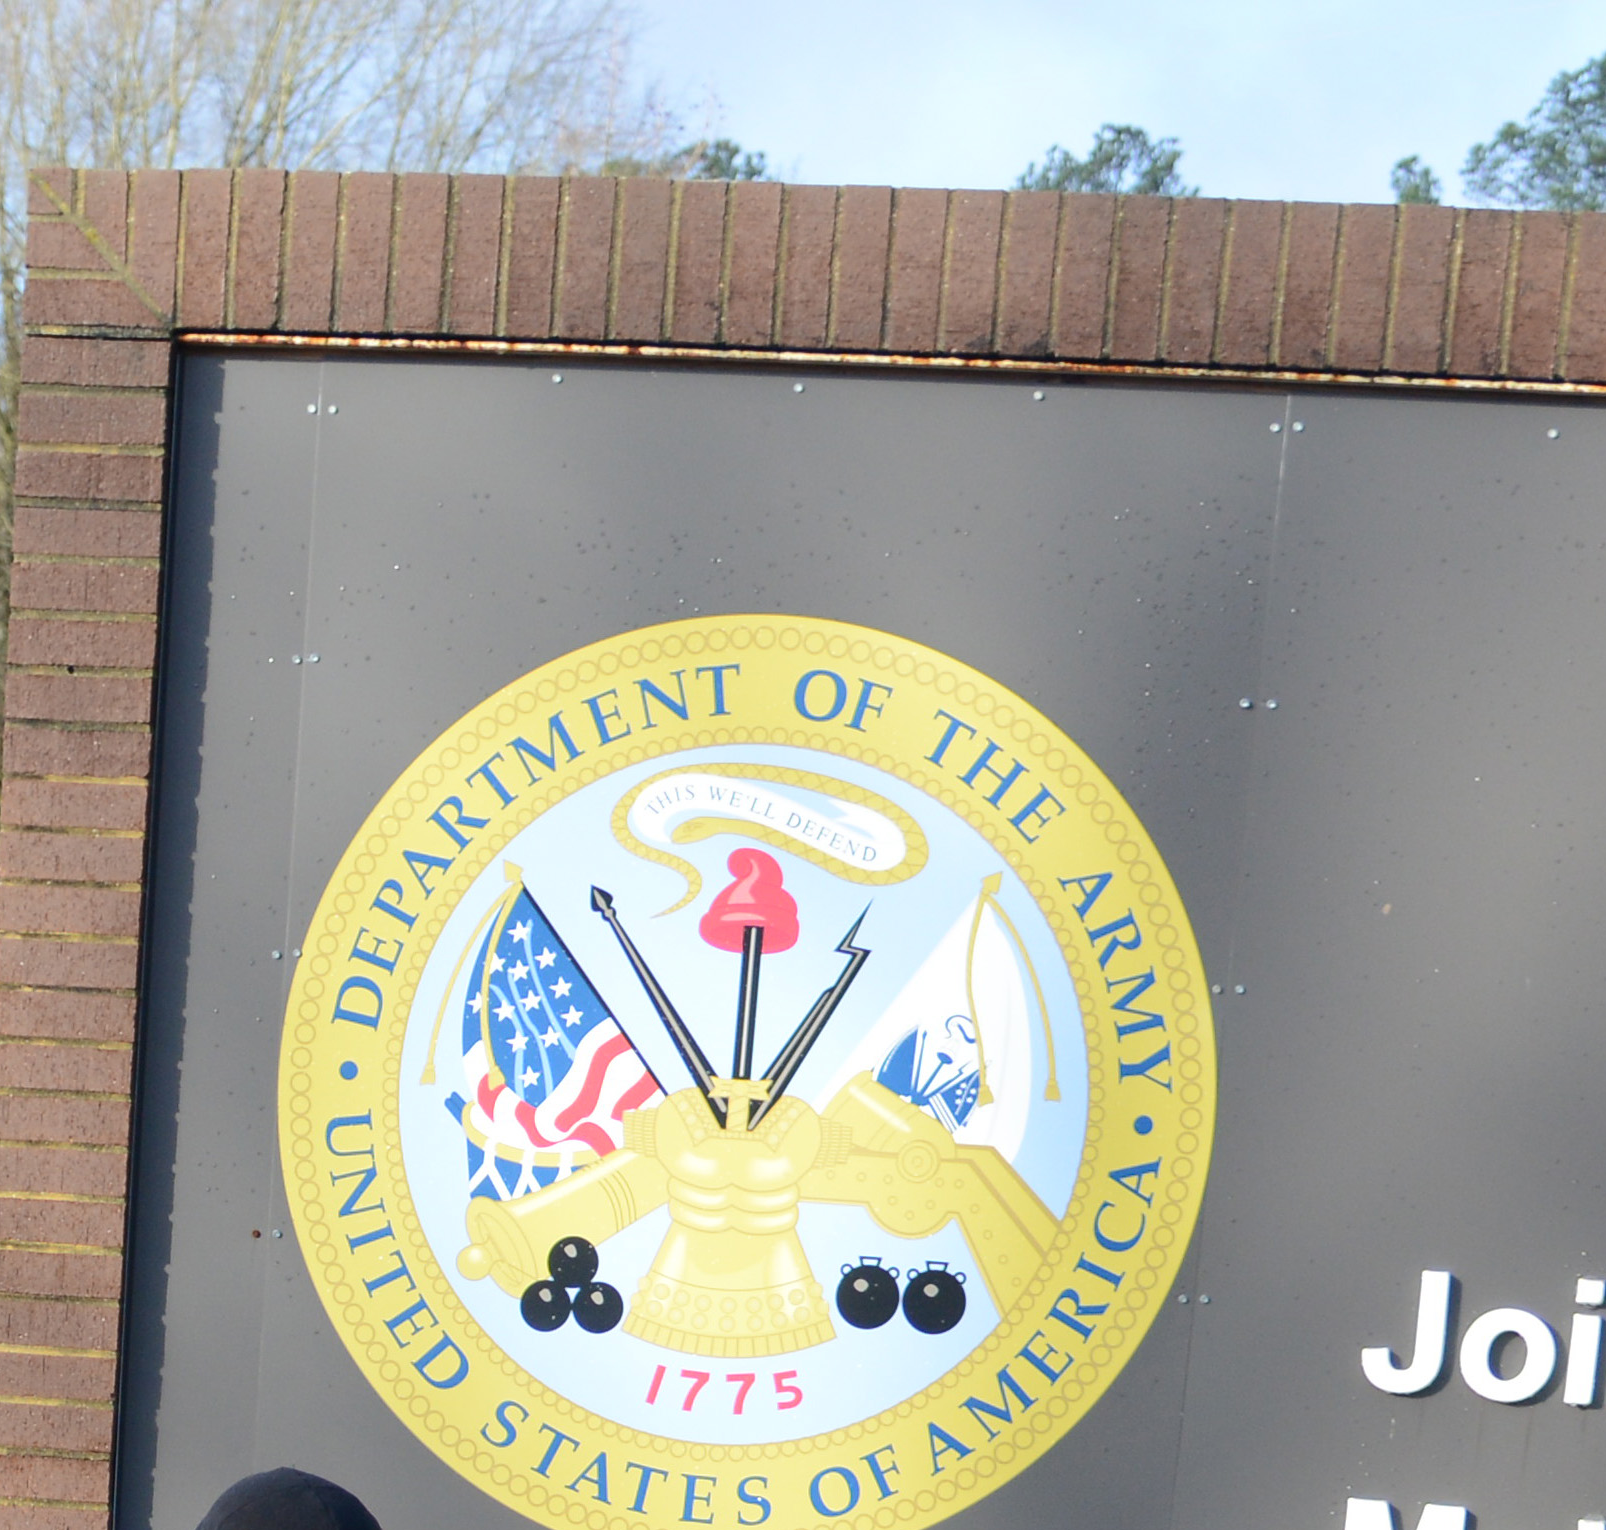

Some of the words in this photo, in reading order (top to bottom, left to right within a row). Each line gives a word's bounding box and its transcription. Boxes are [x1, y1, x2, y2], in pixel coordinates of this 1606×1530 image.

[332, 662, 742, 1030] DEPARTMENT
[792, 668, 894, 733] OF
[924, 708, 1067, 846] THE
[1058, 867, 1173, 1094] ARMY
[644, 784, 696, 817] THIS
[709, 785, 777, 820] WE'LL
[786, 811, 878, 863] DEFEND
[324, 1108, 472, 1391] UNITED
[479, 1399, 772, 1526] STATES
[808, 1444, 903, 1518] OF
[927, 1154, 1163, 1473] AMERICA
[644, 1364, 804, 1415] 1775
